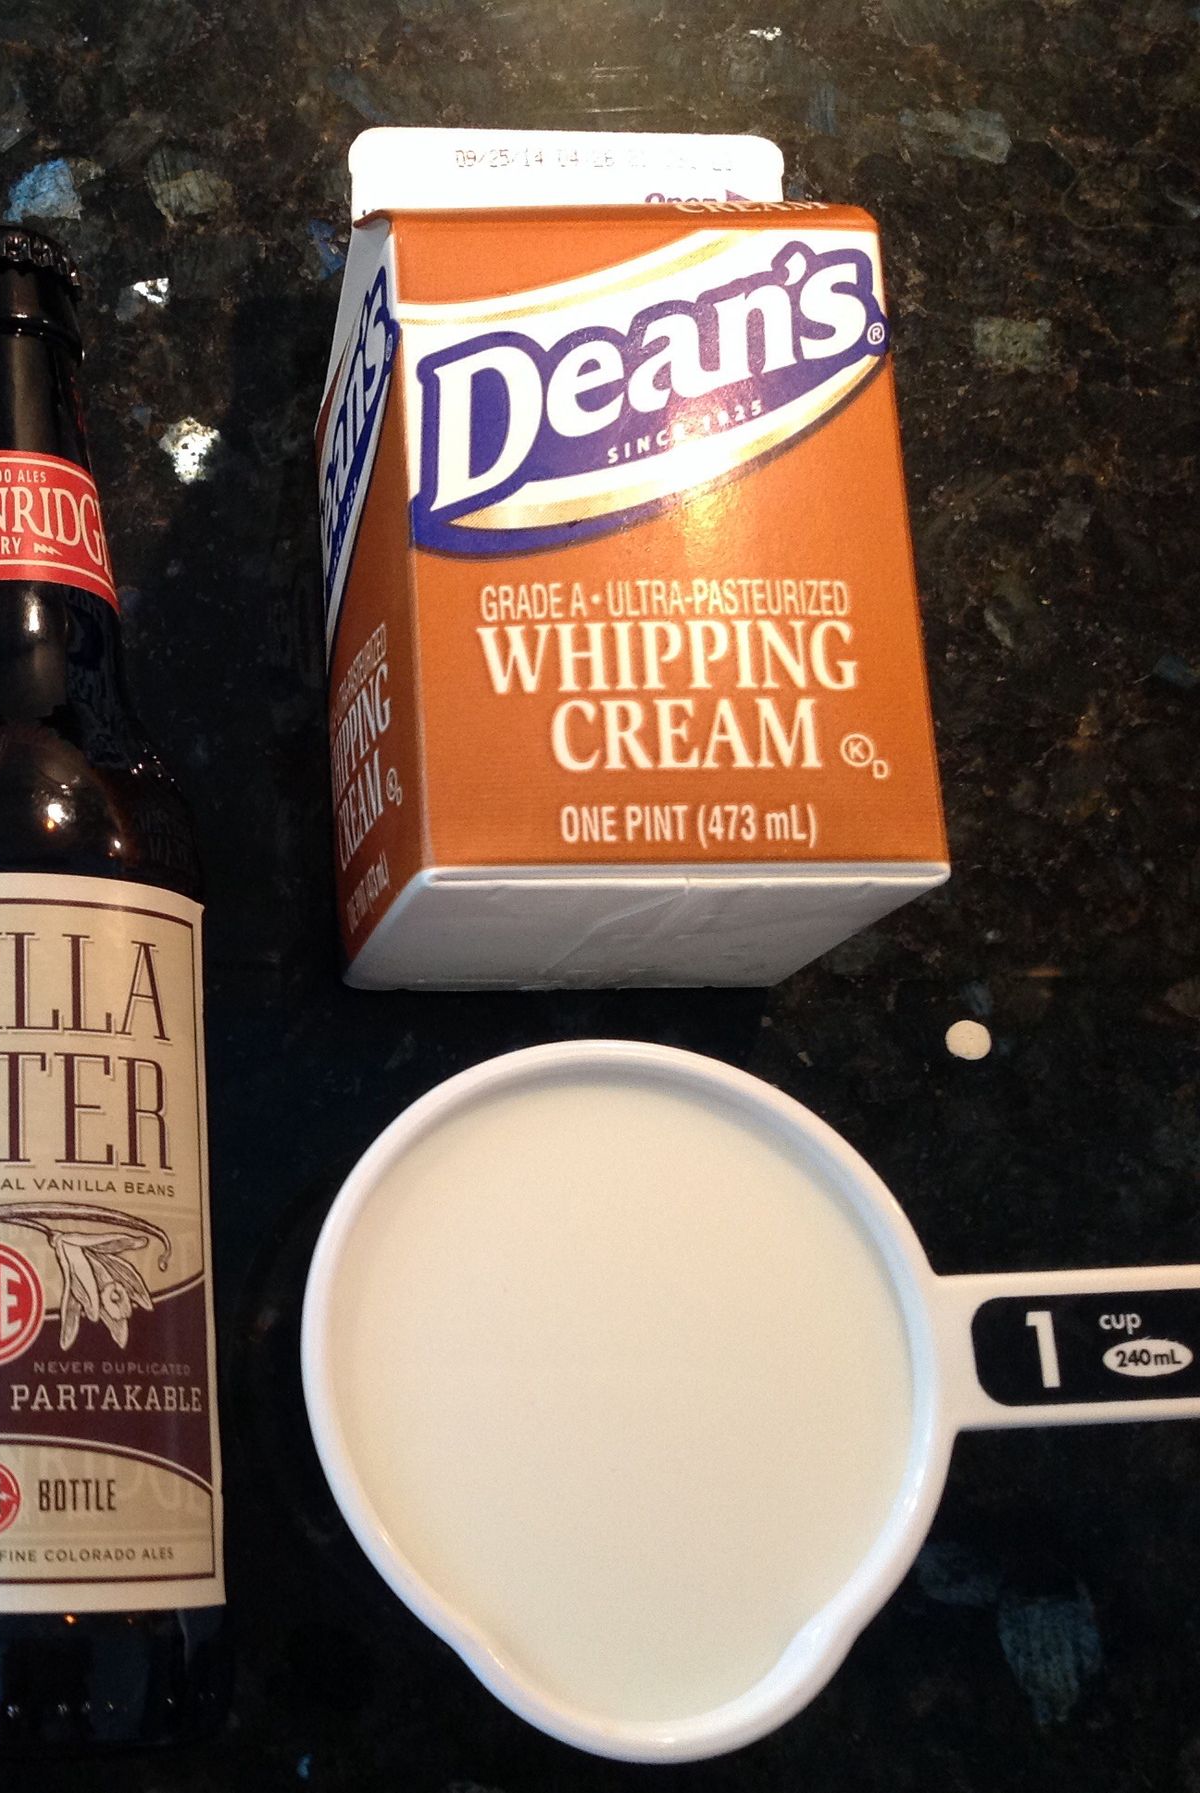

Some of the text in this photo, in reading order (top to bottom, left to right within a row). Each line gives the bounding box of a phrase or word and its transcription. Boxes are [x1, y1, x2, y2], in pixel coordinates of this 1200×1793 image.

[430, 250, 867, 512] Dean's
[321, 284, 386, 600] ean's
[17, 470, 47, 483] ALES
[481, 579, 850, 622] GRADE A ULTRA-PASTEURIZED
[477, 619, 858, 695] WHIPPING
[551, 698, 823, 773] CREAM
[561, 803, 817, 849] ONE PINT (473 mL)
[33, 1178, 117, 1194] VANILLA
[125, 1182, 175, 1198] BEANS
[1099, 1312, 1142, 1335] cup
[34, 1360, 191, 1376] NEVER DUPLICATED
[1025, 1310, 1061, 1388] 1
[10, 1384, 202, 1412] PARTAKABLE
[38, 1479, 117, 1512] BOTTLE
[44, 1549, 136, 1562] COLORADO
[142, 1546, 174, 1560] ALES
